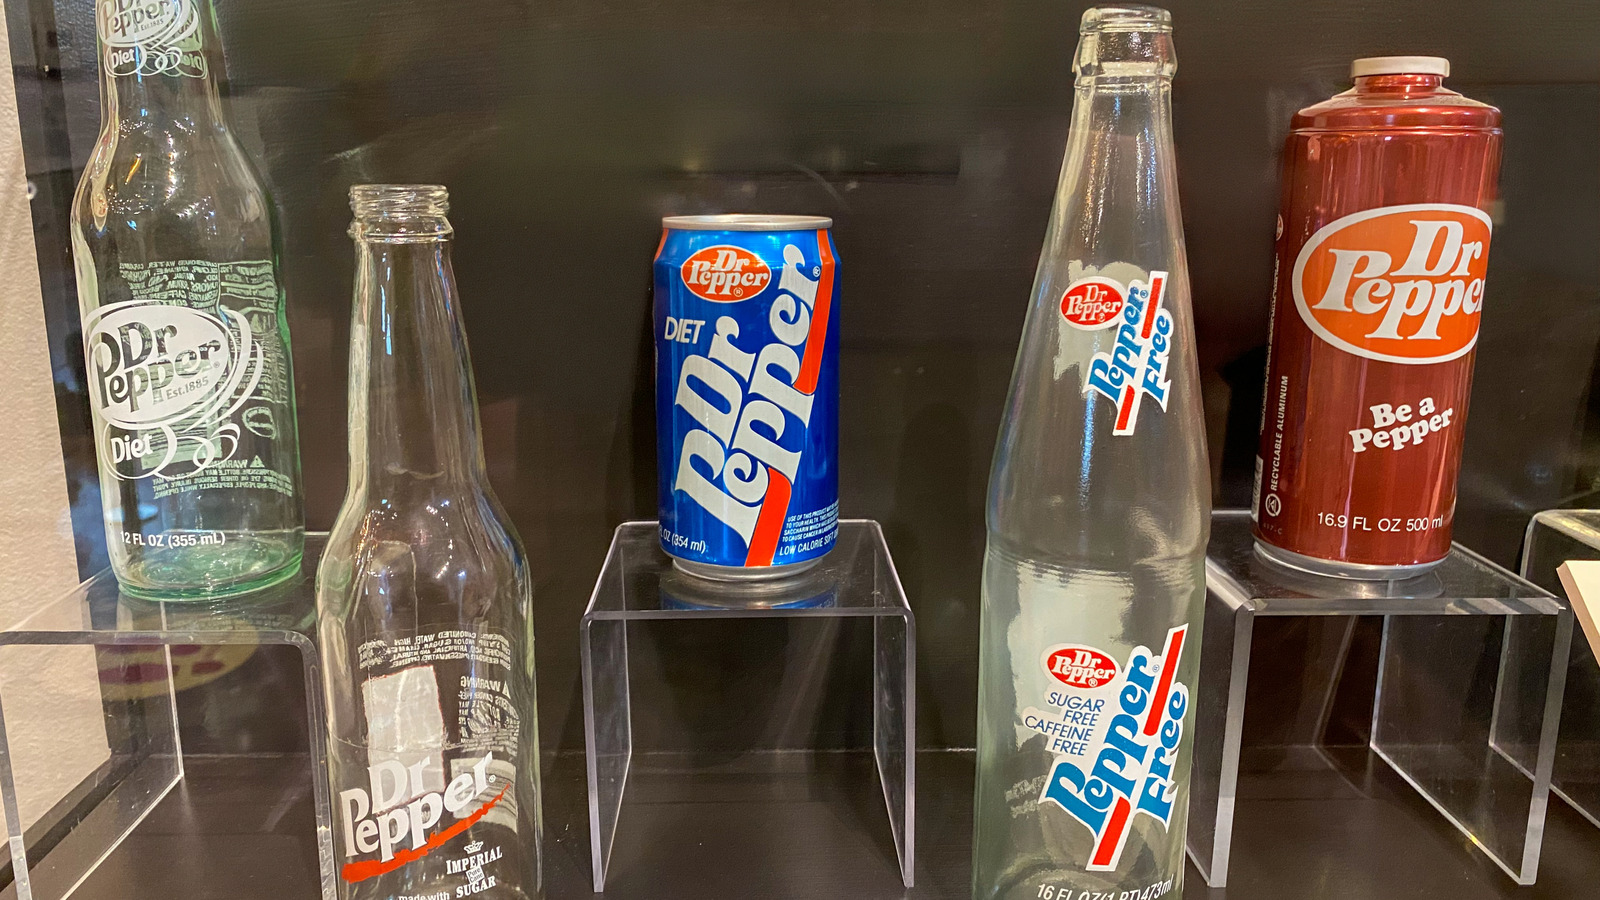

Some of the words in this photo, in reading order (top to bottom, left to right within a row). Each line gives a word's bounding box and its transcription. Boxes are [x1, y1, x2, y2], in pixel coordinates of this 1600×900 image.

[111, 48, 135, 68] Diet
[710, 250, 750, 272] Dr
[1389, 220, 1483, 276] Dr
[687, 260, 769, 296] Pepper
[1065, 295, 1122, 321] Pepper
[1084, 285, 1108, 303] Dr
[118, 321, 178, 370] Dr
[664, 316, 706, 345] DIET
[1088, 286, 1145, 403] Pepper
[91, 331, 222, 413] Pepper
[1142, 315, 1170, 403] Free
[674, 243, 820, 549] Pepper
[675, 315, 757, 450] Dr
[1276, 375, 1289, 431] ALUMINUM
[1369, 403, 1413, 428] Be
[1419, 397, 1436, 417] a
[1348, 407, 1454, 453] Pepper
[111, 434, 153, 464] Diet
[1270, 432, 1283, 491] RECYCLABLE
[1317, 511, 1348, 528] 16.9
[1352, 516, 1372, 531] FL
[1377, 518, 1402, 532] OZ
[1406, 517, 1429, 532] 500
[1431, 514, 1444, 529] ml
[120, 531, 131, 544] 12
[132, 533, 146, 546] FL
[148, 534, 165, 547] OZ
[168, 533, 196, 549] (355
[200, 531, 226, 546] mL)
[663, 528, 671, 542] OZ
[671, 533, 689, 549] (354
[690, 540, 706, 555] ml)
[779, 544, 797, 556] LOW
[797, 537, 823, 553] CALORIE
[1051, 655, 1116, 685] Pepper
[1071, 650, 1102, 669] Dr
[1047, 691, 1105, 713] SUGAR
[1024, 715, 1094, 742] CAFFEINE
[1063, 709, 1100, 727] FREE
[1046, 654, 1159, 837] Pepper
[1052, 738, 1088, 756] FREE
[1137, 690, 1187, 824] Free
[367, 756, 430, 815] Dr
[339, 751, 493, 863] Pepper
[445, 845, 503, 875] IMPERIAL
[456, 875, 497, 898] SUGAR
[1037, 883, 1055, 899] 16
